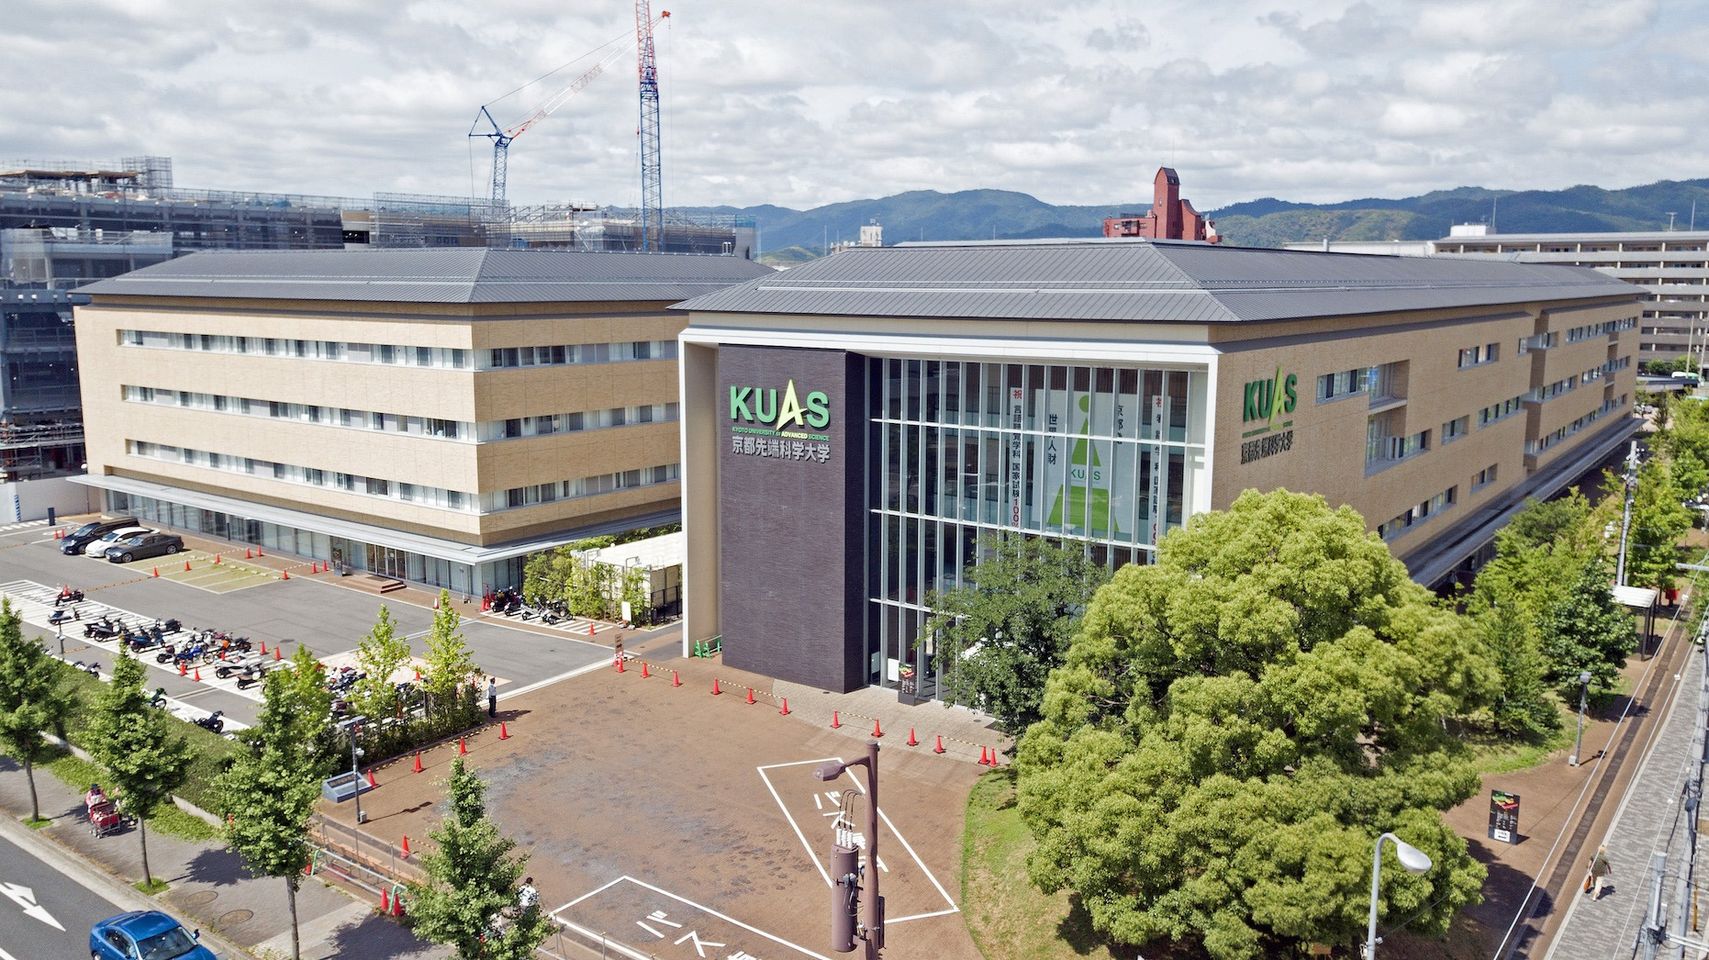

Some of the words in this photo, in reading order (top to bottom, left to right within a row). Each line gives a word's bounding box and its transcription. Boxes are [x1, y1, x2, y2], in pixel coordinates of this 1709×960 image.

[730, 379, 830, 430] KUAS
[1243, 367, 1298, 425] KUAS
[781, 431, 808, 439] ADVANCED
[732, 436, 830, 463] 京都先端科学大学
[1071, 468, 1101, 481] KUS
